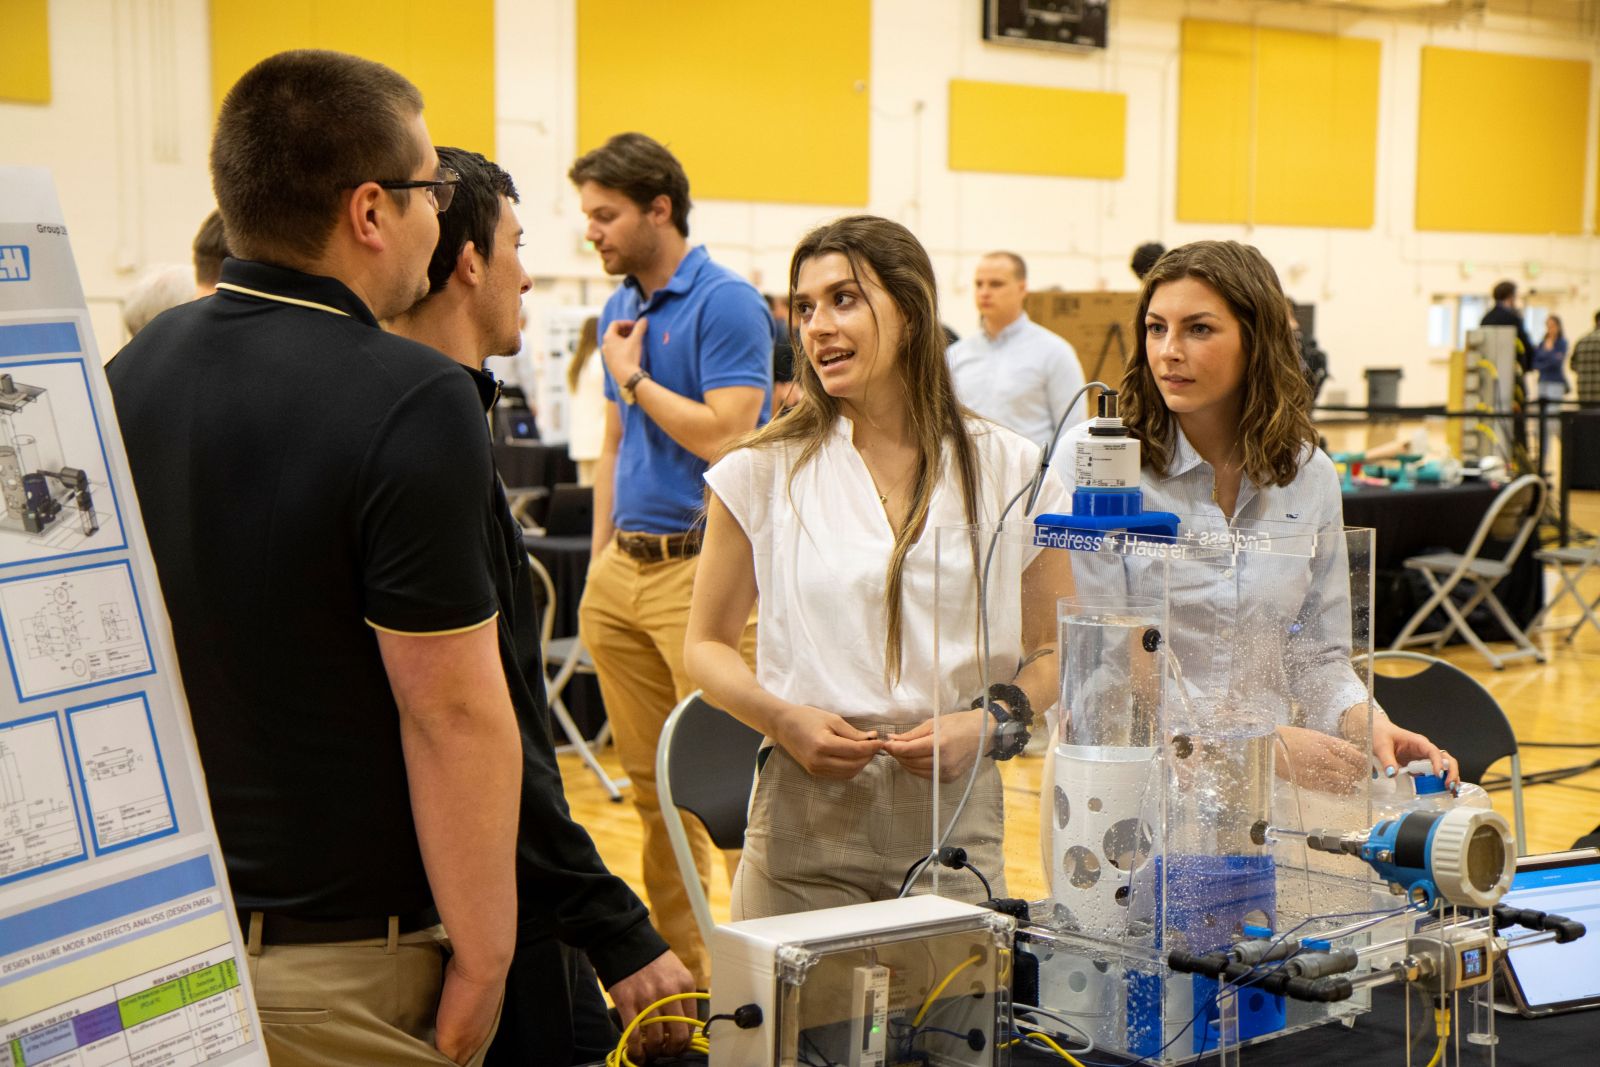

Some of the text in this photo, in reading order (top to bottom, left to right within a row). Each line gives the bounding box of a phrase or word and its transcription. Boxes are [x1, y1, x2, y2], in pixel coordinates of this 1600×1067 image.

[36, 224, 60, 237] Group
[1036, 526, 1102, 551] Endress
[1123, 534, 1187, 560] Hauser
[2, 895, 213, 974] DESIGN FAILURE MODE AND EFFECTS ANALYSIS (DESIGN FMEA)
